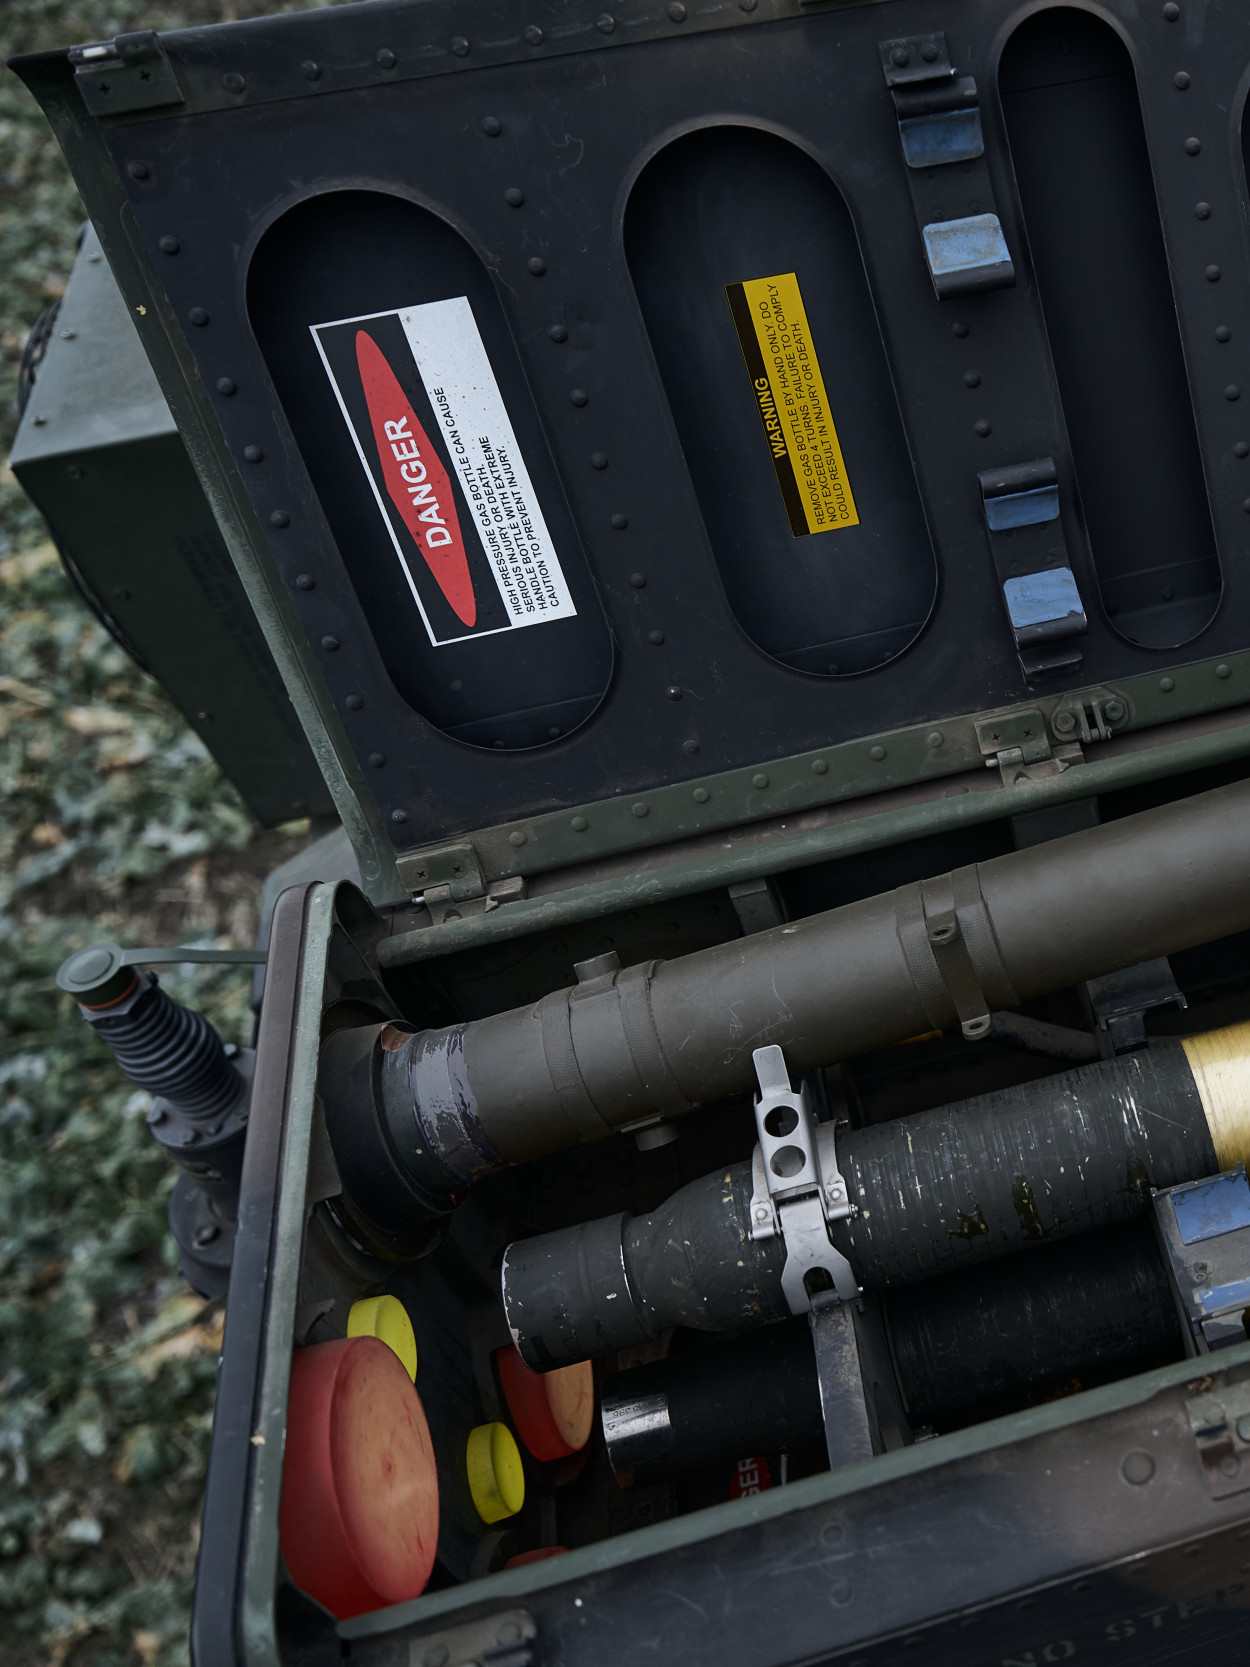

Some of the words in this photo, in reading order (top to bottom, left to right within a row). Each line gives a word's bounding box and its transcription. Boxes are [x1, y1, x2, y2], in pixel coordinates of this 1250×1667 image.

[758, 301, 771, 319] DO
[766, 283, 787, 331] COMPLY
[764, 322, 780, 353] ONLY.
[780, 334, 792, 350] TO
[790, 320, 808, 360] DEATH.
[773, 356, 789, 388] HAND
[784, 351, 805, 399] FAILURE
[801, 363, 813, 380] OR
[433, 387, 455, 427] CAUSE
[754, 377, 786, 458] WARNING
[782, 391, 794, 405] BY
[805, 384, 824, 422] INJURY
[448, 429, 464, 454] CAN
[787, 408, 806, 451] BOTTLE
[799, 402, 816, 443] TURNS.
[817, 425, 827, 436] IN
[458, 456, 482, 500] BOTTLE
[478, 435, 505, 489] EXTREME
[495, 445, 517, 487] INJURY.
[799, 453, 812, 476] GAS
[812, 453, 831, 497] EXCEED
[820, 439, 839, 480] RESULT
[383, 415, 452, 548] DANGER
[475, 463, 496, 503] DEATH.
[805, 478, 826, 524] REMOVE
[832, 482, 849, 519] COULD
[475, 503, 491, 526] GAS
[490, 505, 503, 522] OR
[498, 491, 515, 520] WITH
[510, 490, 536, 540] PREVENT
[823, 500, 837, 522] NOT
[484, 528, 513, 586] PRESSURE
[496, 525, 518, 563] INJURY
[509, 521, 531, 564] BOTTLE
[530, 542, 541, 558] TO
[506, 589, 523, 615] HIGH
[511, 565, 535, 612] SERIOUS
[524, 566, 547, 609] HANDLE
[535, 560, 559, 606] CAUTION
[1104, 1581, 1248, 1642] STEP
